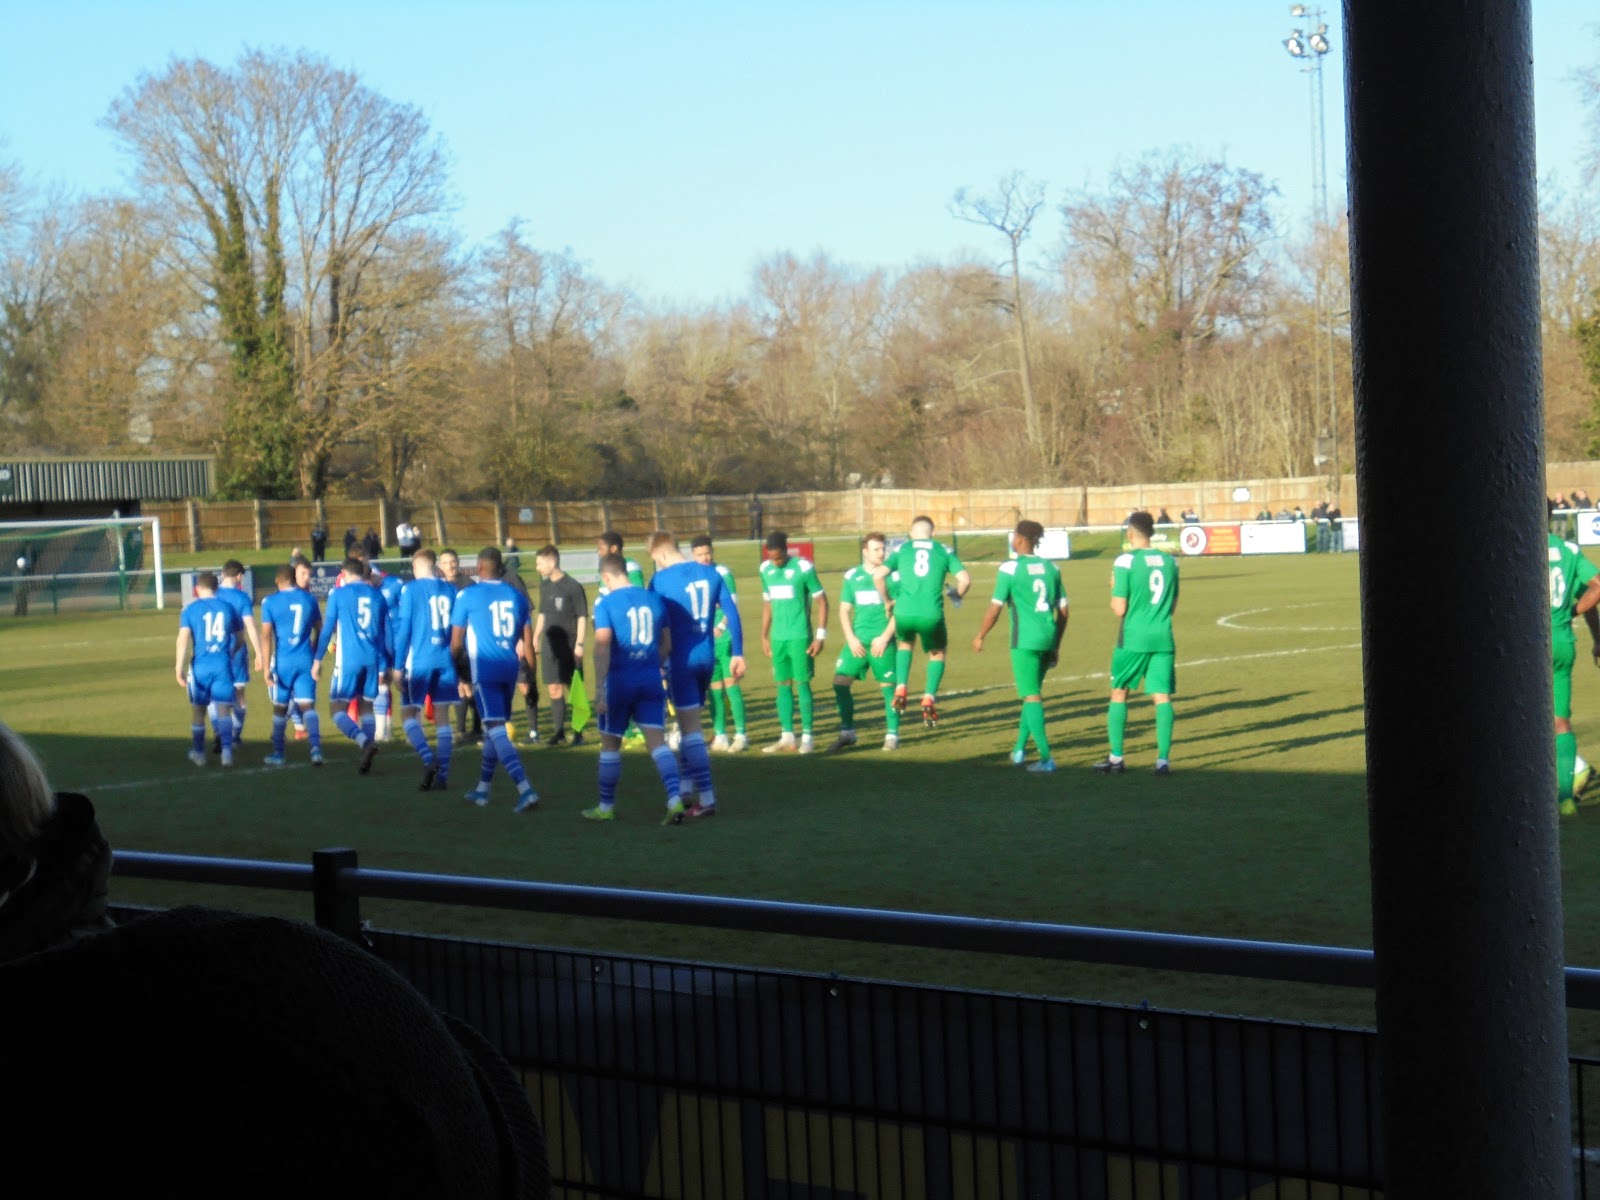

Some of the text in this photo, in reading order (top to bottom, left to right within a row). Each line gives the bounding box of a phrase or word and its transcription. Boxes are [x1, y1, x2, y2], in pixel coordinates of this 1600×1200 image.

[913, 549, 929, 577] 8
[684, 579, 710, 620] 17
[1032, 578, 1049, 612] 2
[1149, 569, 1165, 605] 9
[203, 611, 226, 643] 14
[289, 603, 303, 635] 7
[357, 597, 371, 630] 5
[488, 600, 515, 638] 15
[626, 605, 653, 646] 10
